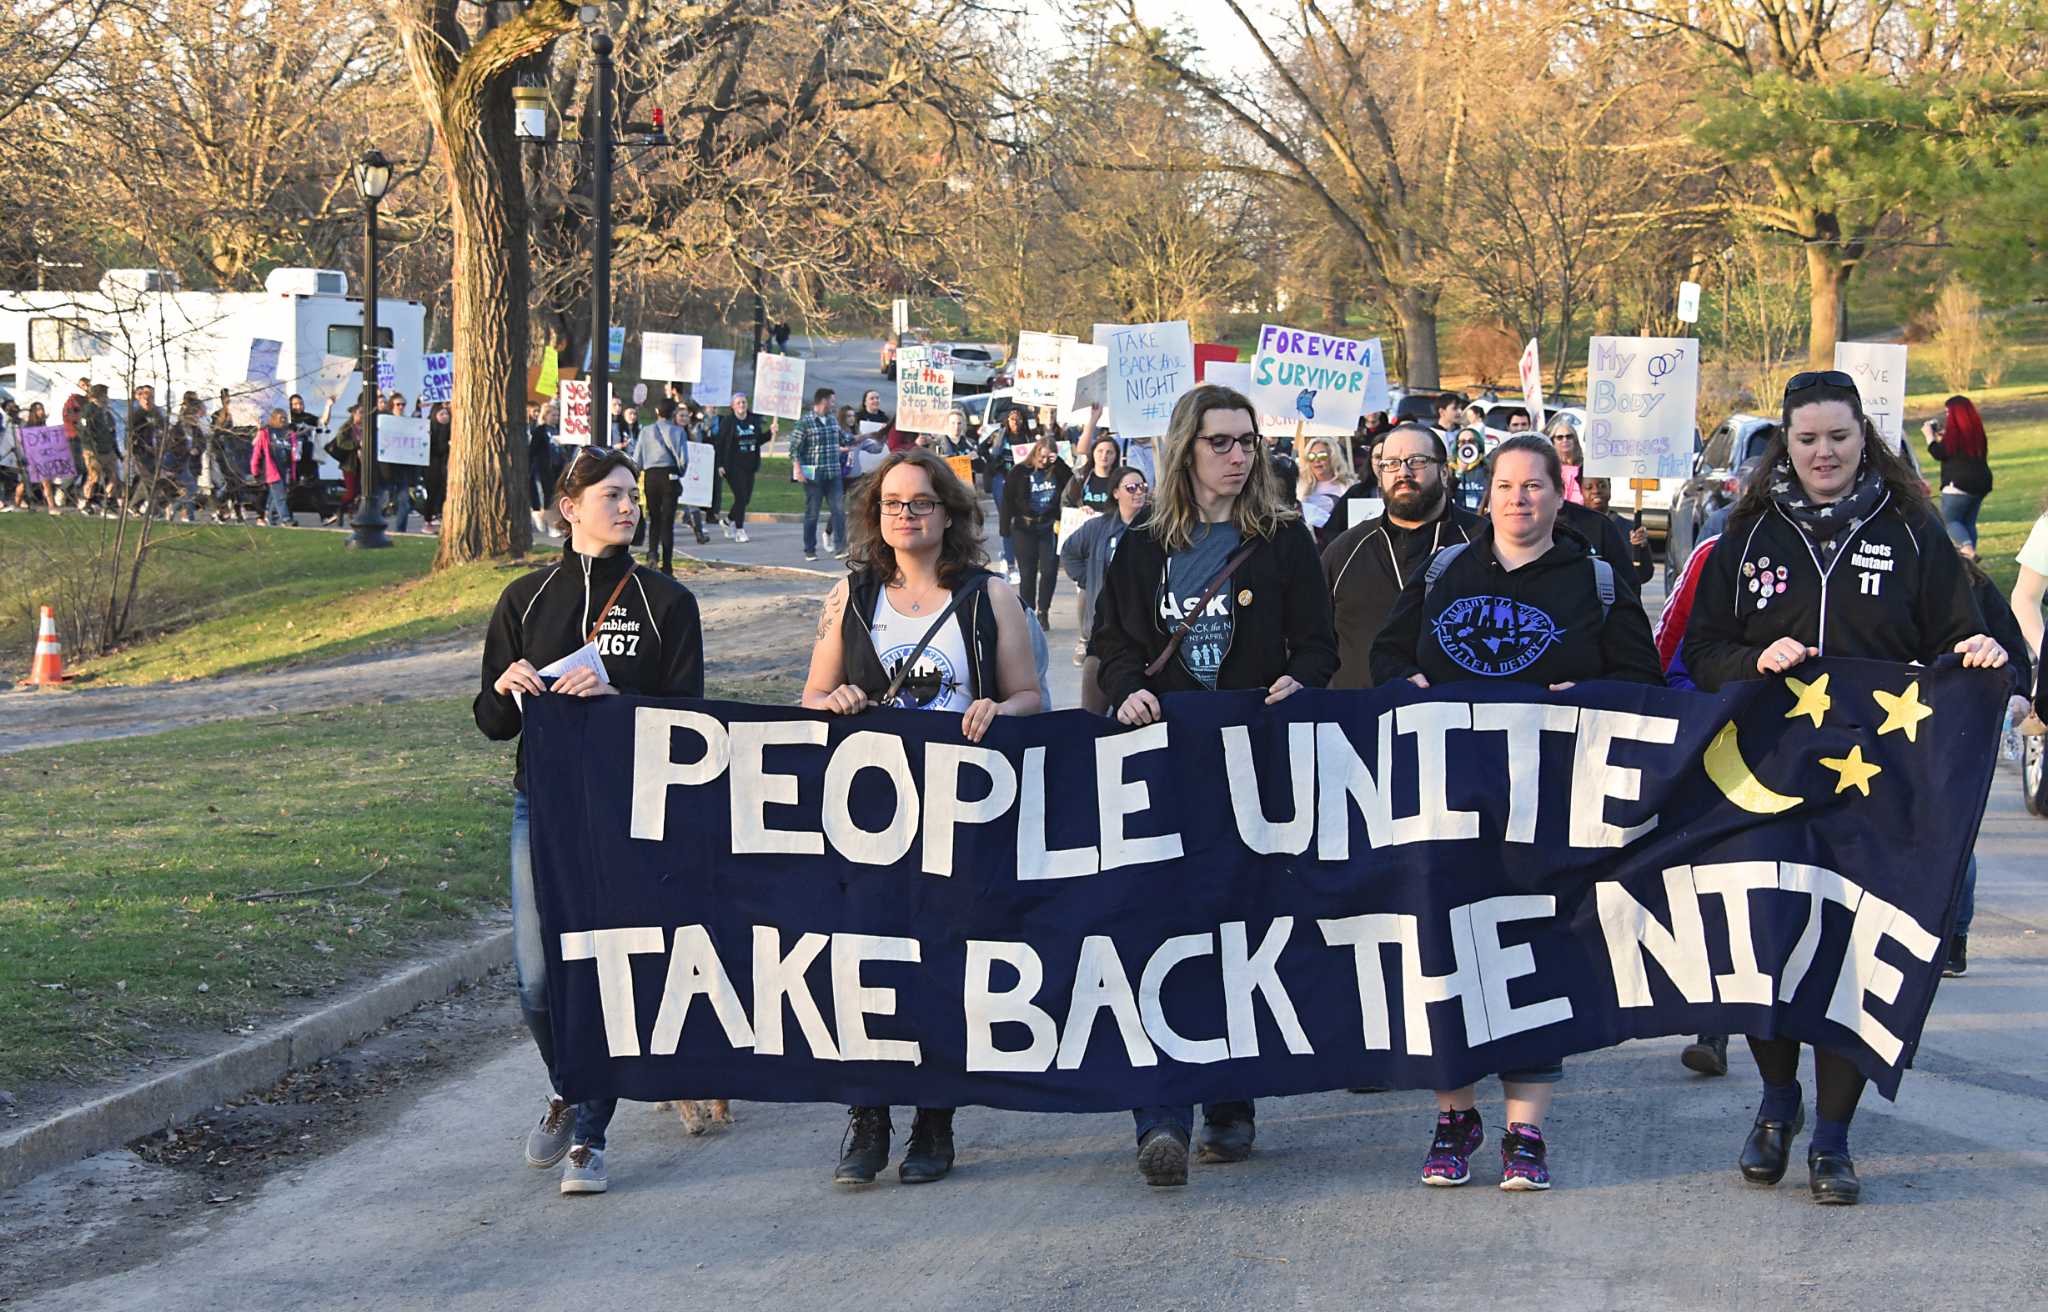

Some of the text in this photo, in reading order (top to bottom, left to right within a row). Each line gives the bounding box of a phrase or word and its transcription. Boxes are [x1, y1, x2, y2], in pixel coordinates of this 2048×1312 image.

[1112, 330, 1159, 353] TAKE
[1263, 327, 1371, 367] FOREVER A
[427, 356, 447, 371] NO
[1119, 355, 1157, 377] BACK
[902, 367, 945, 384] End the
[1257, 357, 1363, 393] SURVIVOR
[903, 381, 949, 397] Silence
[1126, 371, 1178, 404] NIGHT
[1860, 540, 1891, 557] Toots
[1851, 553, 1895, 572] Mutant
[1858, 571, 1881, 596] 11
[592, 619, 640, 632] mblette
[630, 702, 1680, 881] PEOPLE UNITE
[559, 861, 1942, 1073] TAKE BACK THE NITE
